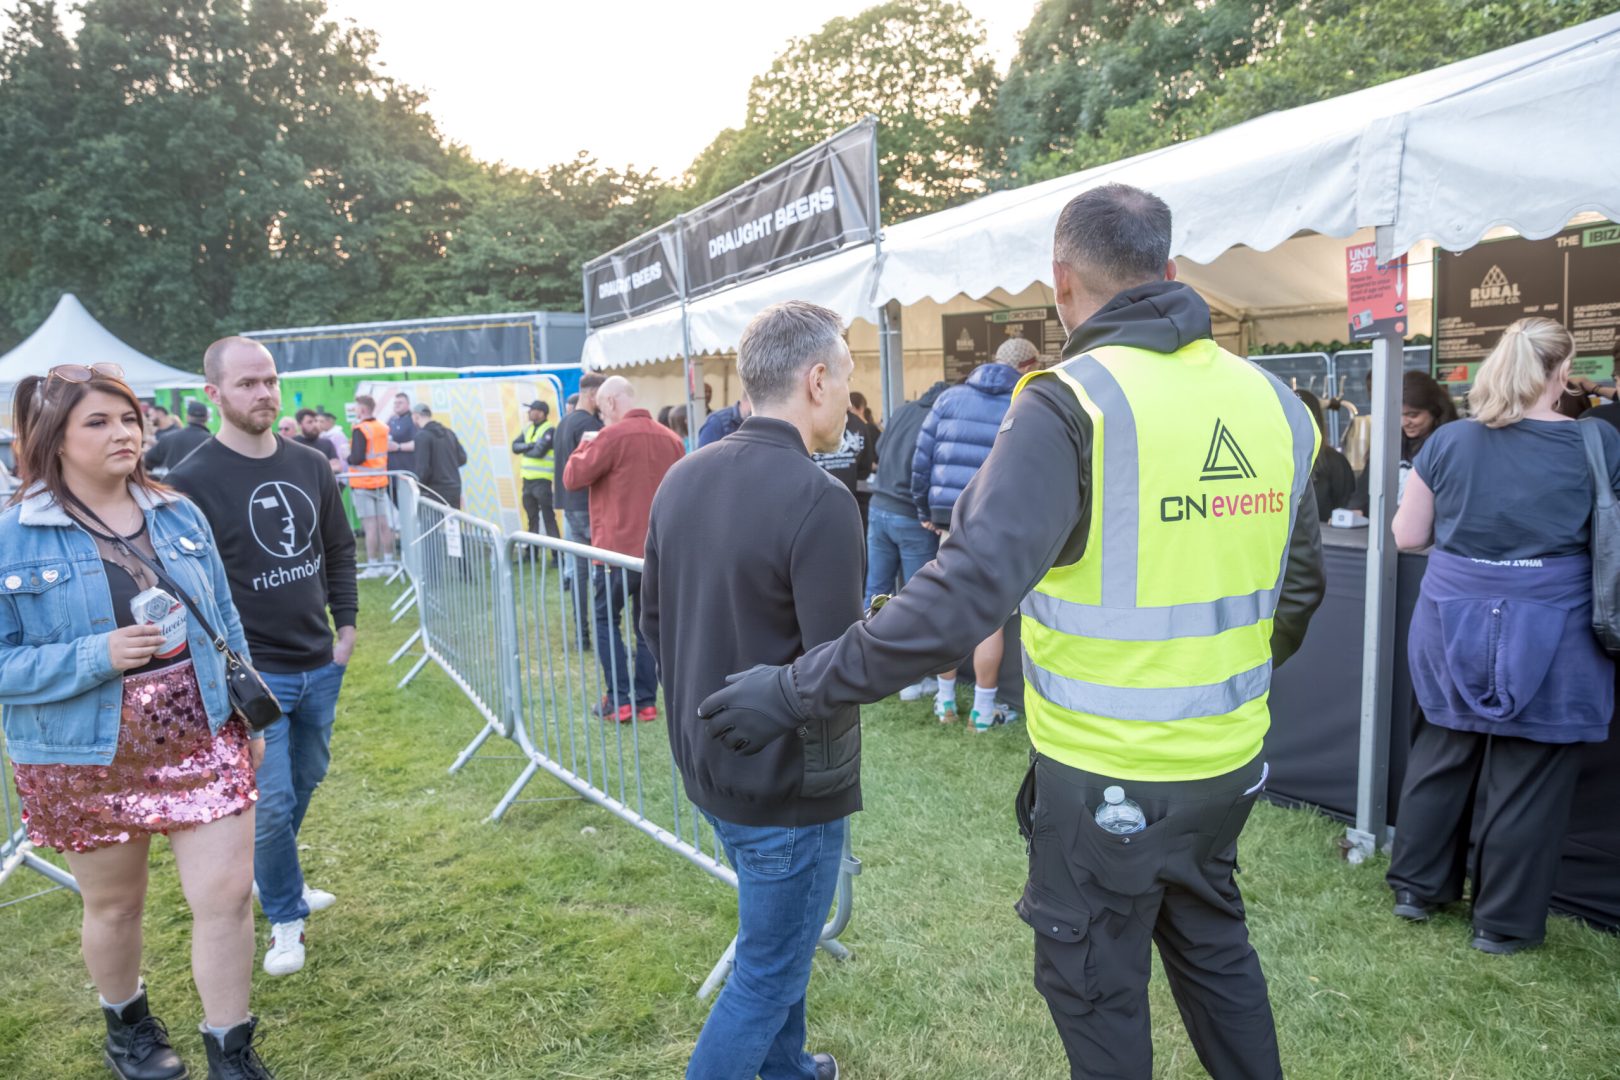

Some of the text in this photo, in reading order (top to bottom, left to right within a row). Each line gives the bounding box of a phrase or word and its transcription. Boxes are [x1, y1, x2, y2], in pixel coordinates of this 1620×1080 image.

[708, 185, 835, 259] DRAUGHT BEERS
[1555, 234, 1580, 248] THE
[1349, 245, 1376, 261] UND
[632, 261, 662, 290] BEERS
[1350, 260, 1369, 274] 25?
[1470, 283, 1521, 302] RURAL
